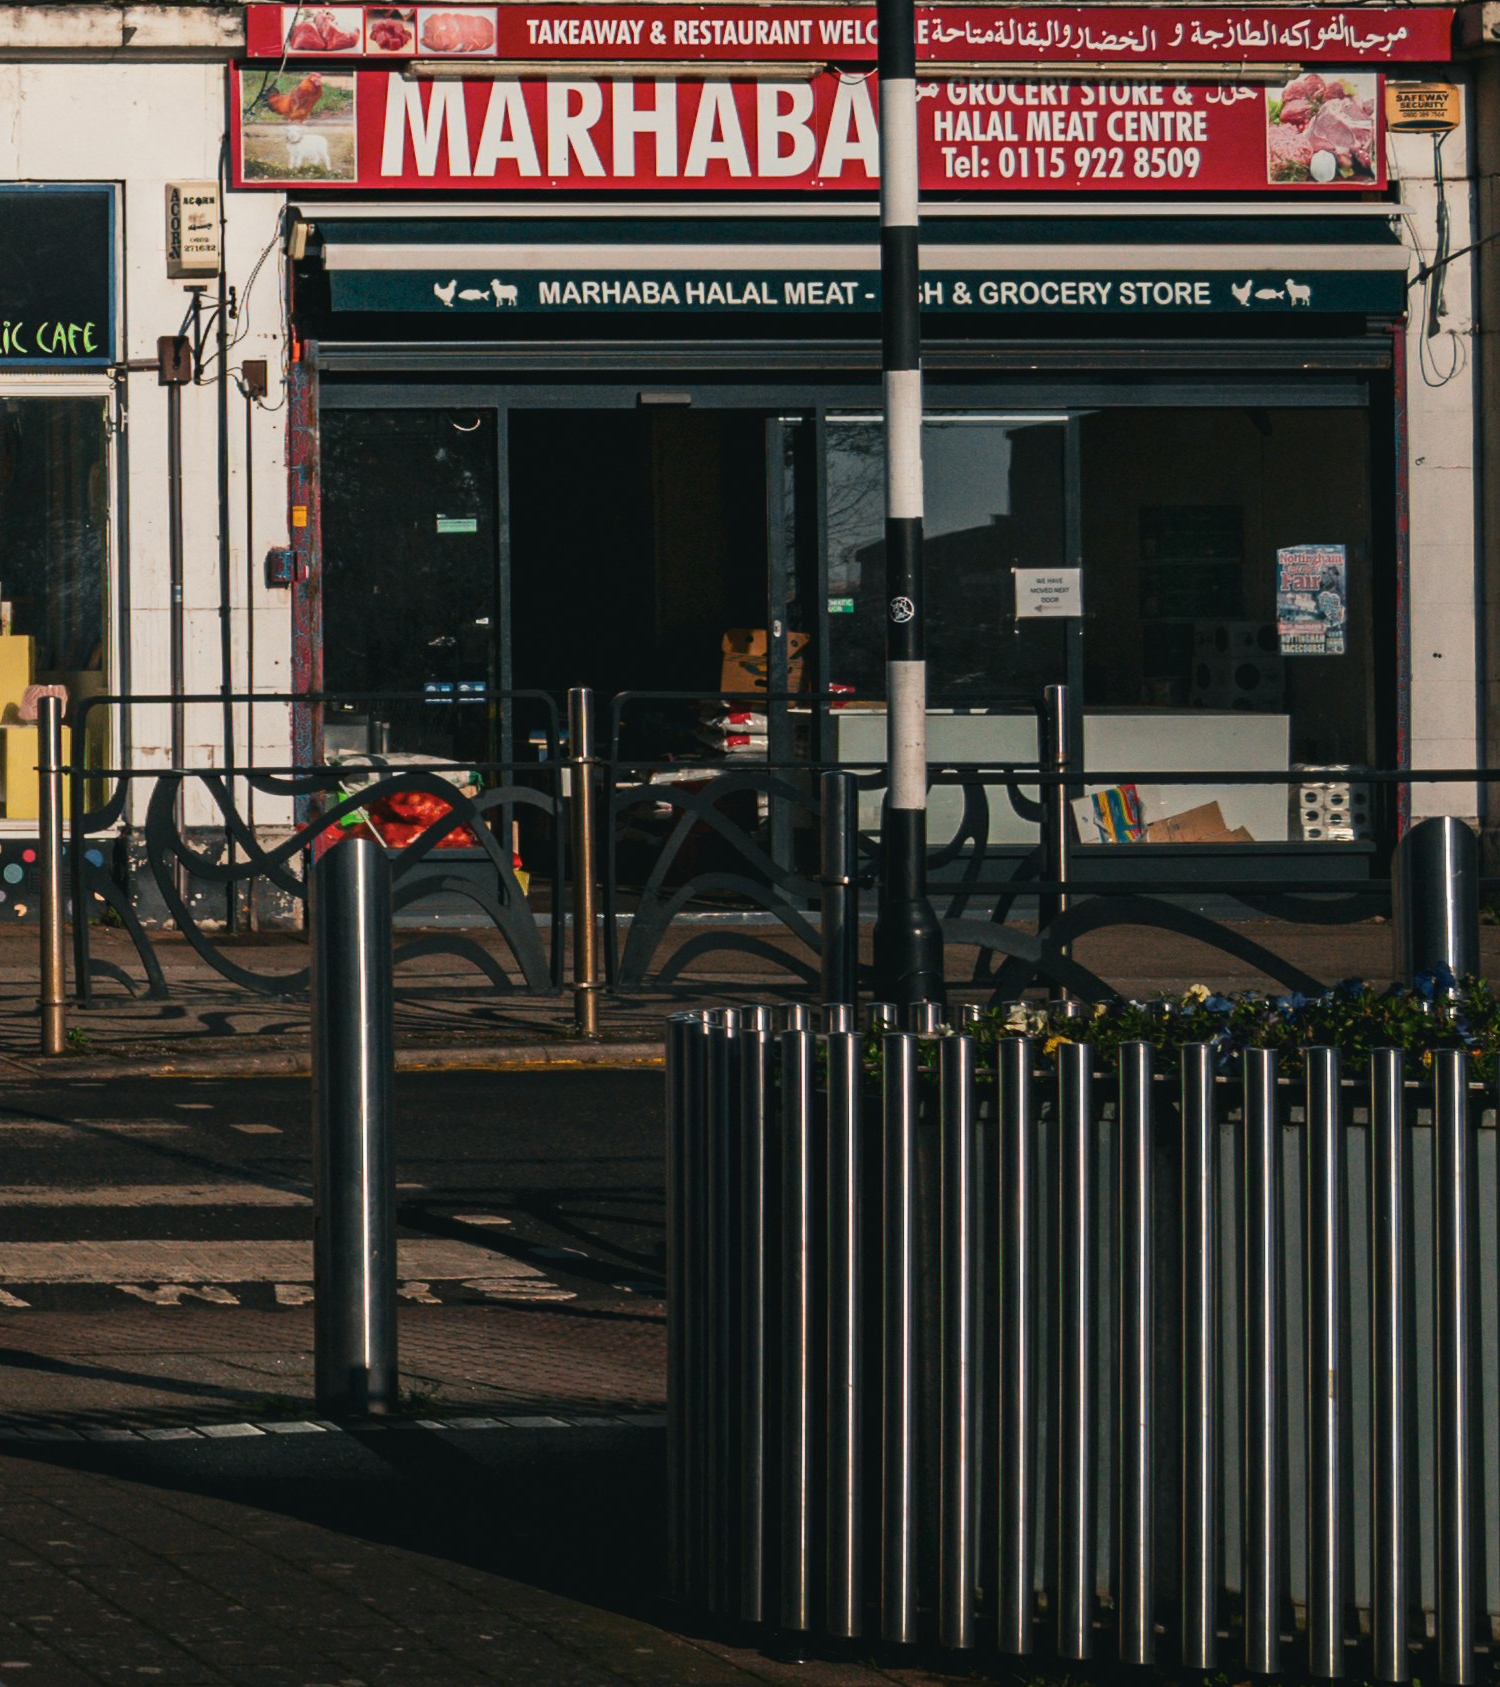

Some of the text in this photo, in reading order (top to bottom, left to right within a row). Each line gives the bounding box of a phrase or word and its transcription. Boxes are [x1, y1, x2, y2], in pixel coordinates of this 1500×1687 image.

[527, 19, 929, 46] TAKEAWAY & RESTAURANT WELCE
[947, 77, 1072, 106] GROCERY
[1079, 77, 1163, 106] STORE
[1173, 79, 1194, 106] &
[1396, 94, 1449, 102] SAFEWAY
[380, 73, 880, 178] MARHABA
[934, 110, 1208, 142] HALAL MEAT CENTRE
[942, 146, 1201, 179] Tel: 0115 922 8509
[169, 188, 181, 259] ACORN
[538, 281, 679, 304] MARHABA
[686, 281, 777, 304] HALAL
[784, 281, 858, 304] MEAT
[953, 281, 973, 305] &
[979, 281, 1113, 305] GROCERY
[1119, 281, 1211, 305] STORE
[36, 320, 98, 355] CAFE
[1279, 552, 1343, 565] Nottingham
[1281, 572, 1321, 591] Fair
